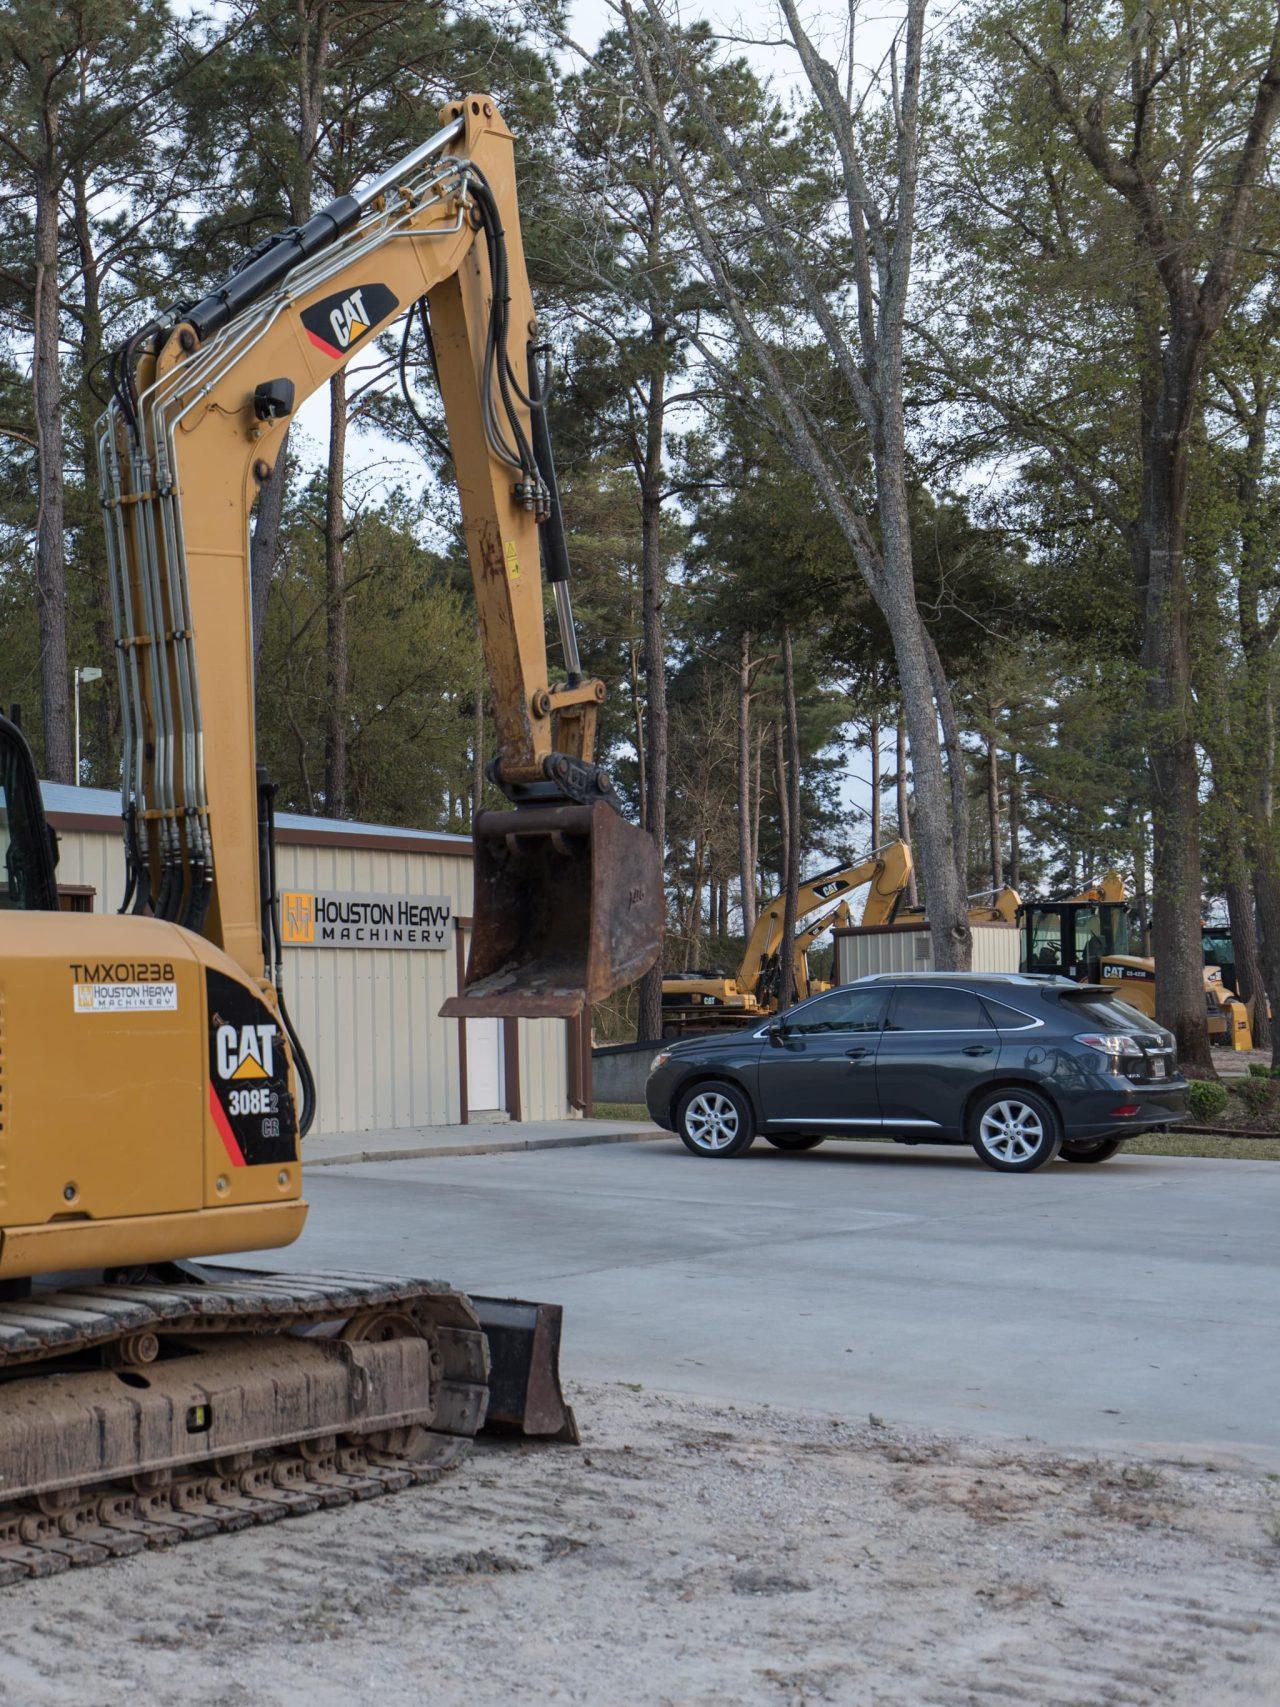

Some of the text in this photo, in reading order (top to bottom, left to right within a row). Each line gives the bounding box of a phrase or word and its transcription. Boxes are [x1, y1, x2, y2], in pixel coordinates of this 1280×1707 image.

[330, 289, 371, 347] CAT
[822, 882, 839, 896] CAT
[314, 897, 450, 927] HOUSTON HEAVY
[322, 927, 444, 943] MACHINERY
[1103, 965, 1124, 979] CAT
[94, 985, 139, 998] HOUSTON
[142, 984, 174, 997] HEAVY
[98, 998, 170, 1006] MACHINERY
[703, 996, 715, 1005] CAT
[217, 1024, 277, 1080] CAT
[261, 1117, 280, 1138] CR
